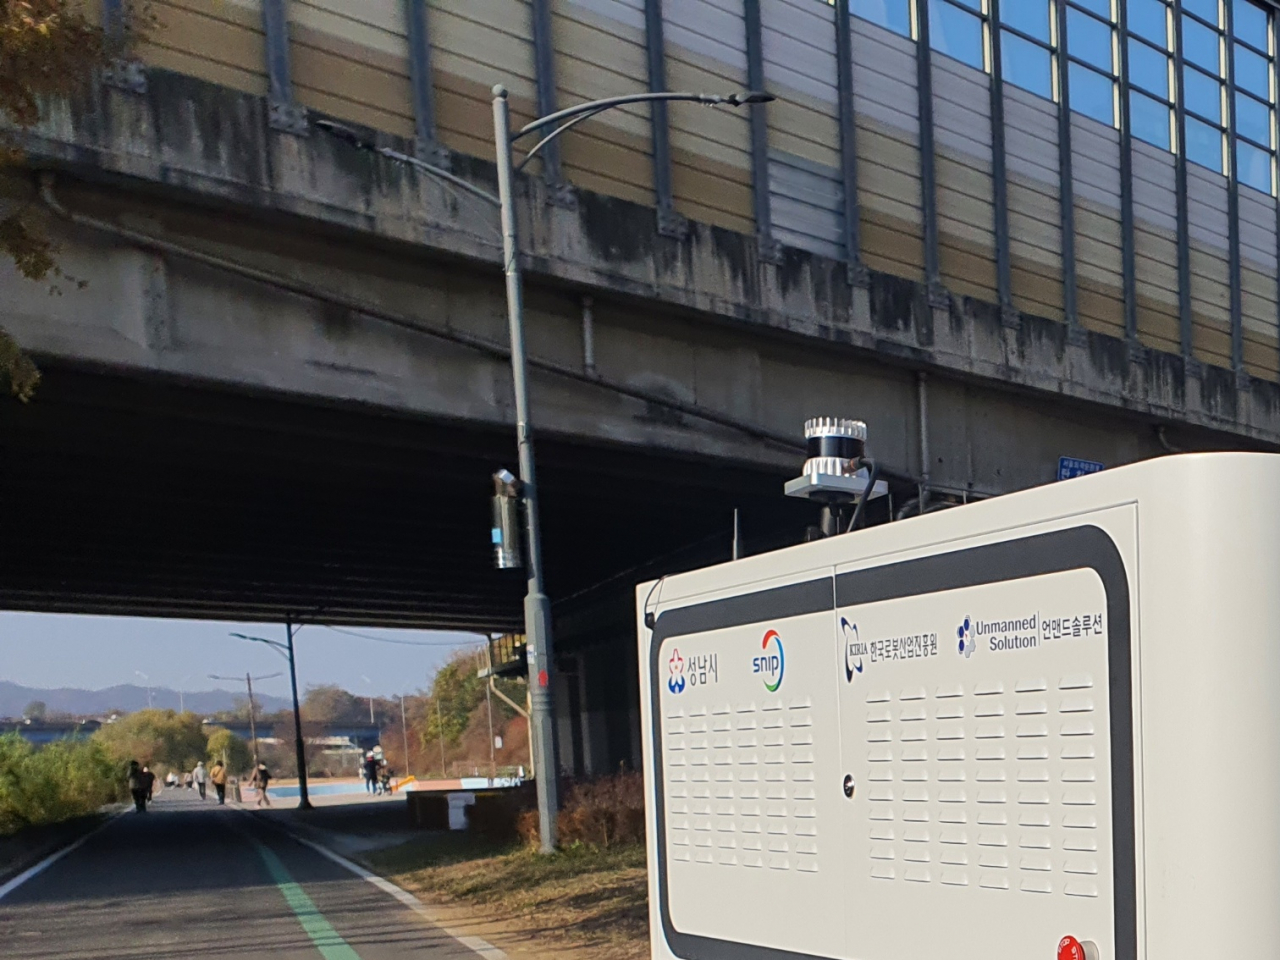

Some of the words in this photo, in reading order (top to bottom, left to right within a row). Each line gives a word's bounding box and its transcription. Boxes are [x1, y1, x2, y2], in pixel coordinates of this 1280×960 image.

[976, 614, 1037, 636] Unmanned
[1042, 613, 1103, 640] 언맨드솔루션
[870, 632, 938, 662] 한국로봇산업진흥원
[989, 635, 1037, 651] Solution
[687, 652, 718, 687] 성남시
[752, 655, 779, 677] snip
